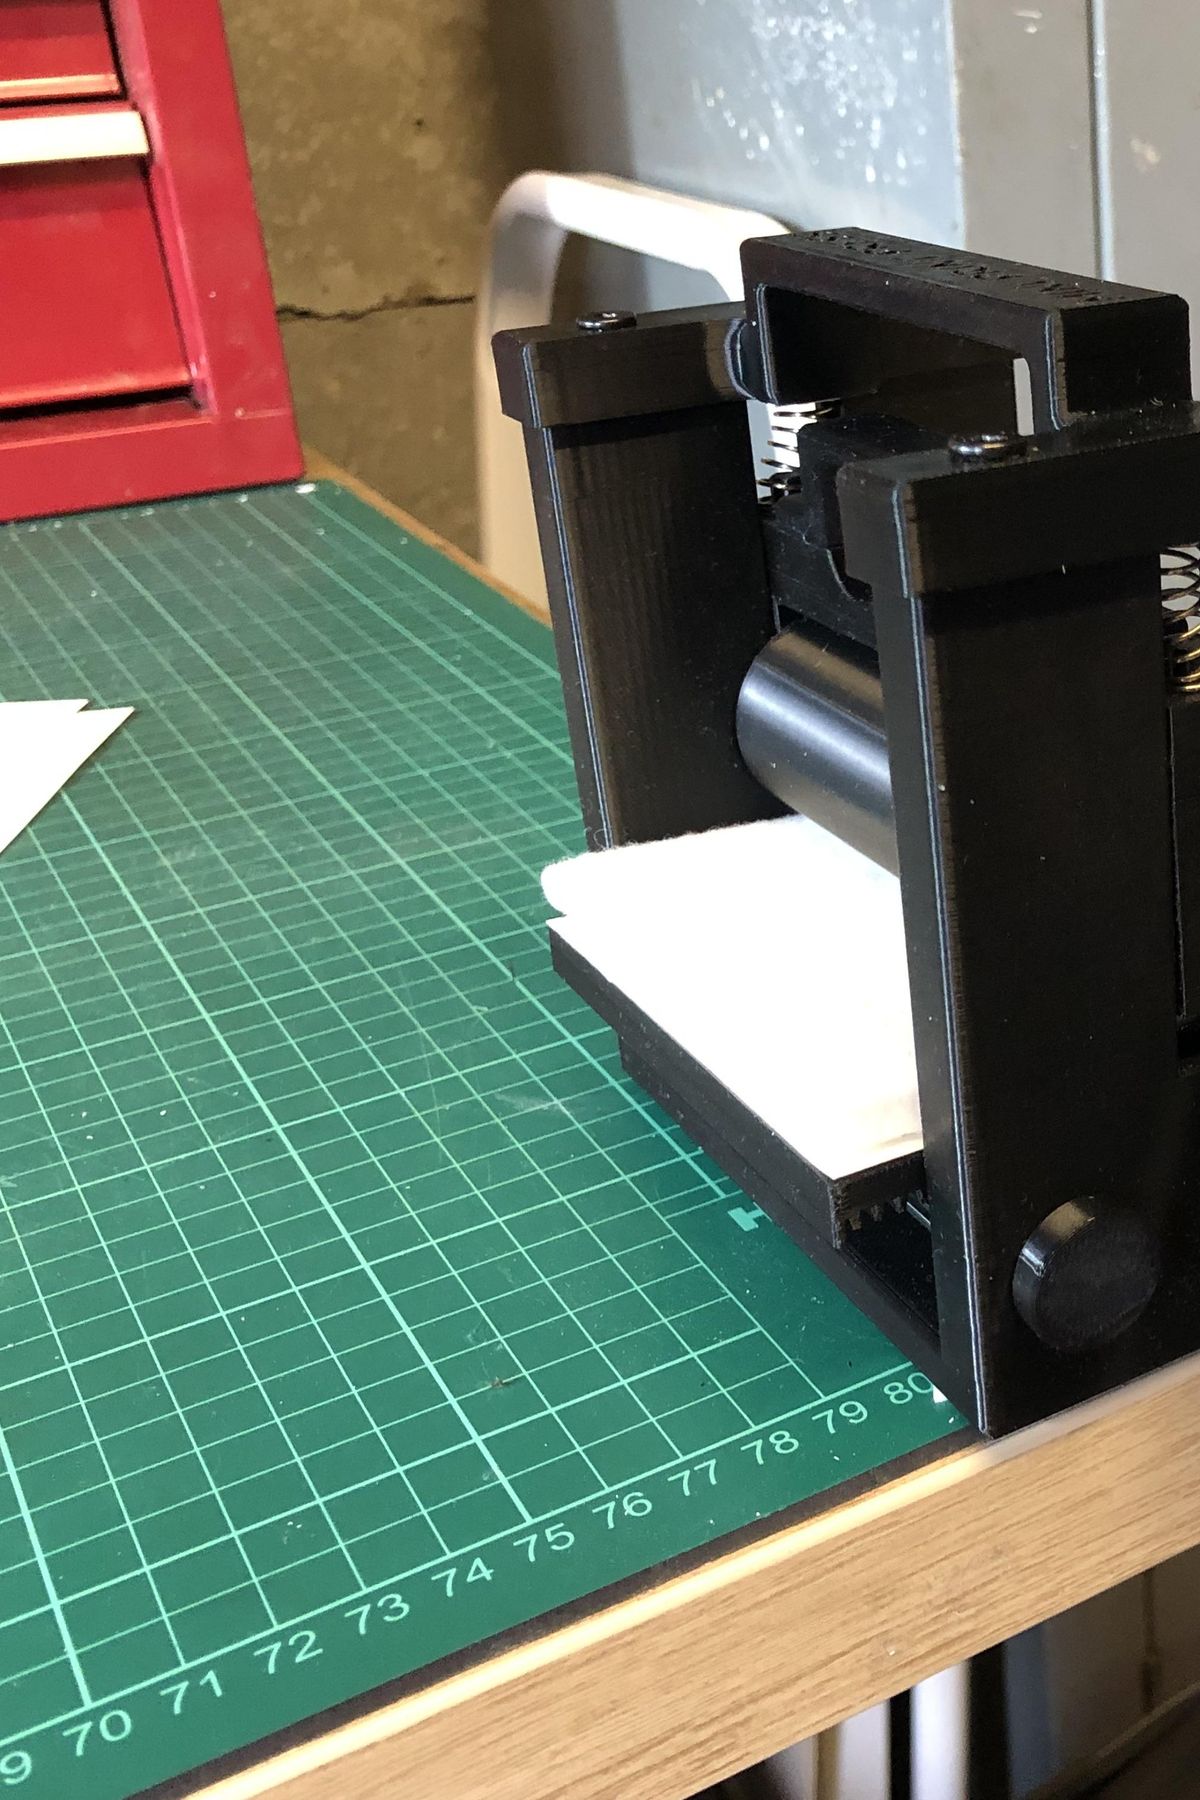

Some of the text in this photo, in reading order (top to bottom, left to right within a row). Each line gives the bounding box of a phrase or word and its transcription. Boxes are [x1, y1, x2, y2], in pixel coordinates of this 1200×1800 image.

[62, 1709, 132, 1757] 70
[159, 1669, 223, 1714] 71
[253, 1630, 324, 1674] 72
[344, 1593, 410, 1635] 73
[430, 1557, 494, 1597] 74
[512, 1522, 575, 1562] 75
[591, 1491, 653, 1529] 76
[667, 1459, 717, 1496] 77
[740, 1430, 799, 1465] 78
[811, 1400, 868, 1434] 79
[883, 1372, 934, 1404] 80
